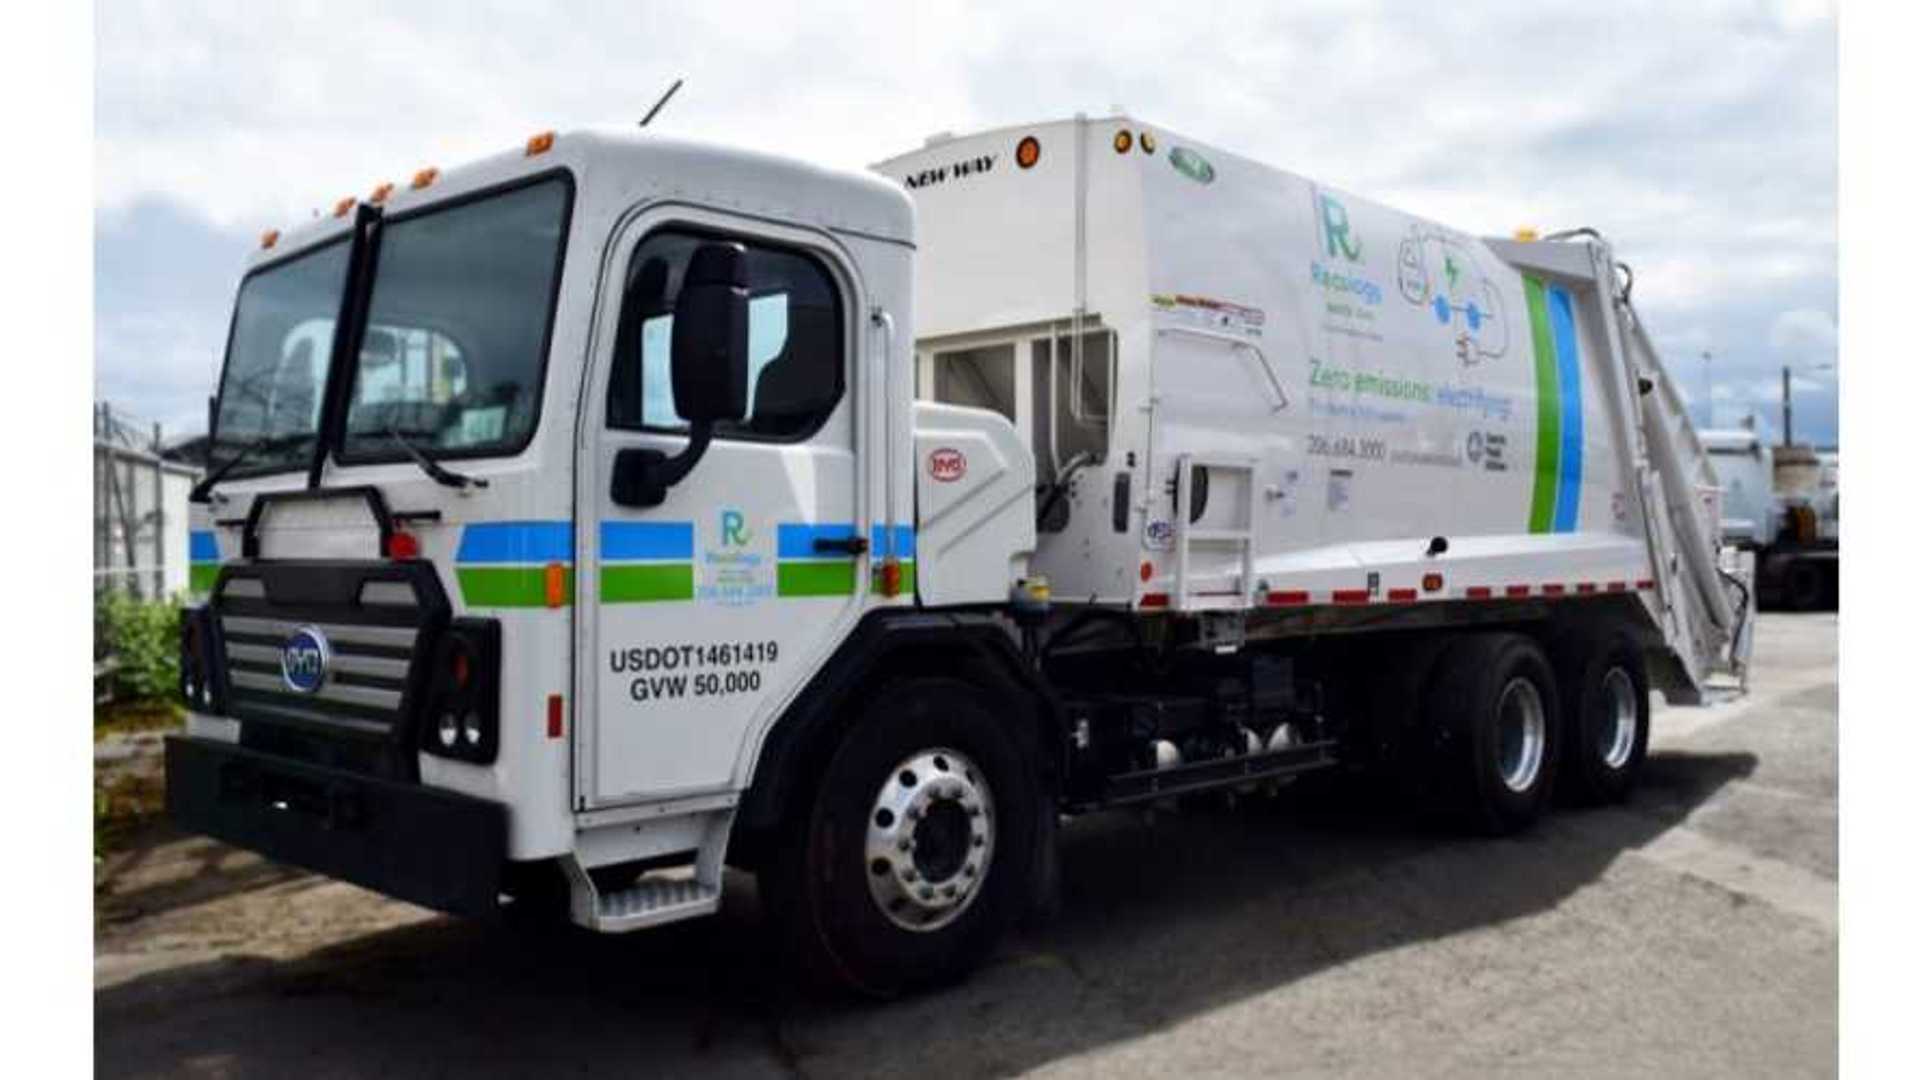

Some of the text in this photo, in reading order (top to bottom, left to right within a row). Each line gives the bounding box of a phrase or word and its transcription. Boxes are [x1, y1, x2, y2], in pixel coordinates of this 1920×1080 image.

[905, 154, 998, 189] NEW WAY
[1310, 357, 1351, 390] Zero
[933, 457, 962, 473] BYD
[610, 640, 778, 673] USDOT1461419
[630, 671, 760, 701] GVW 50,000
